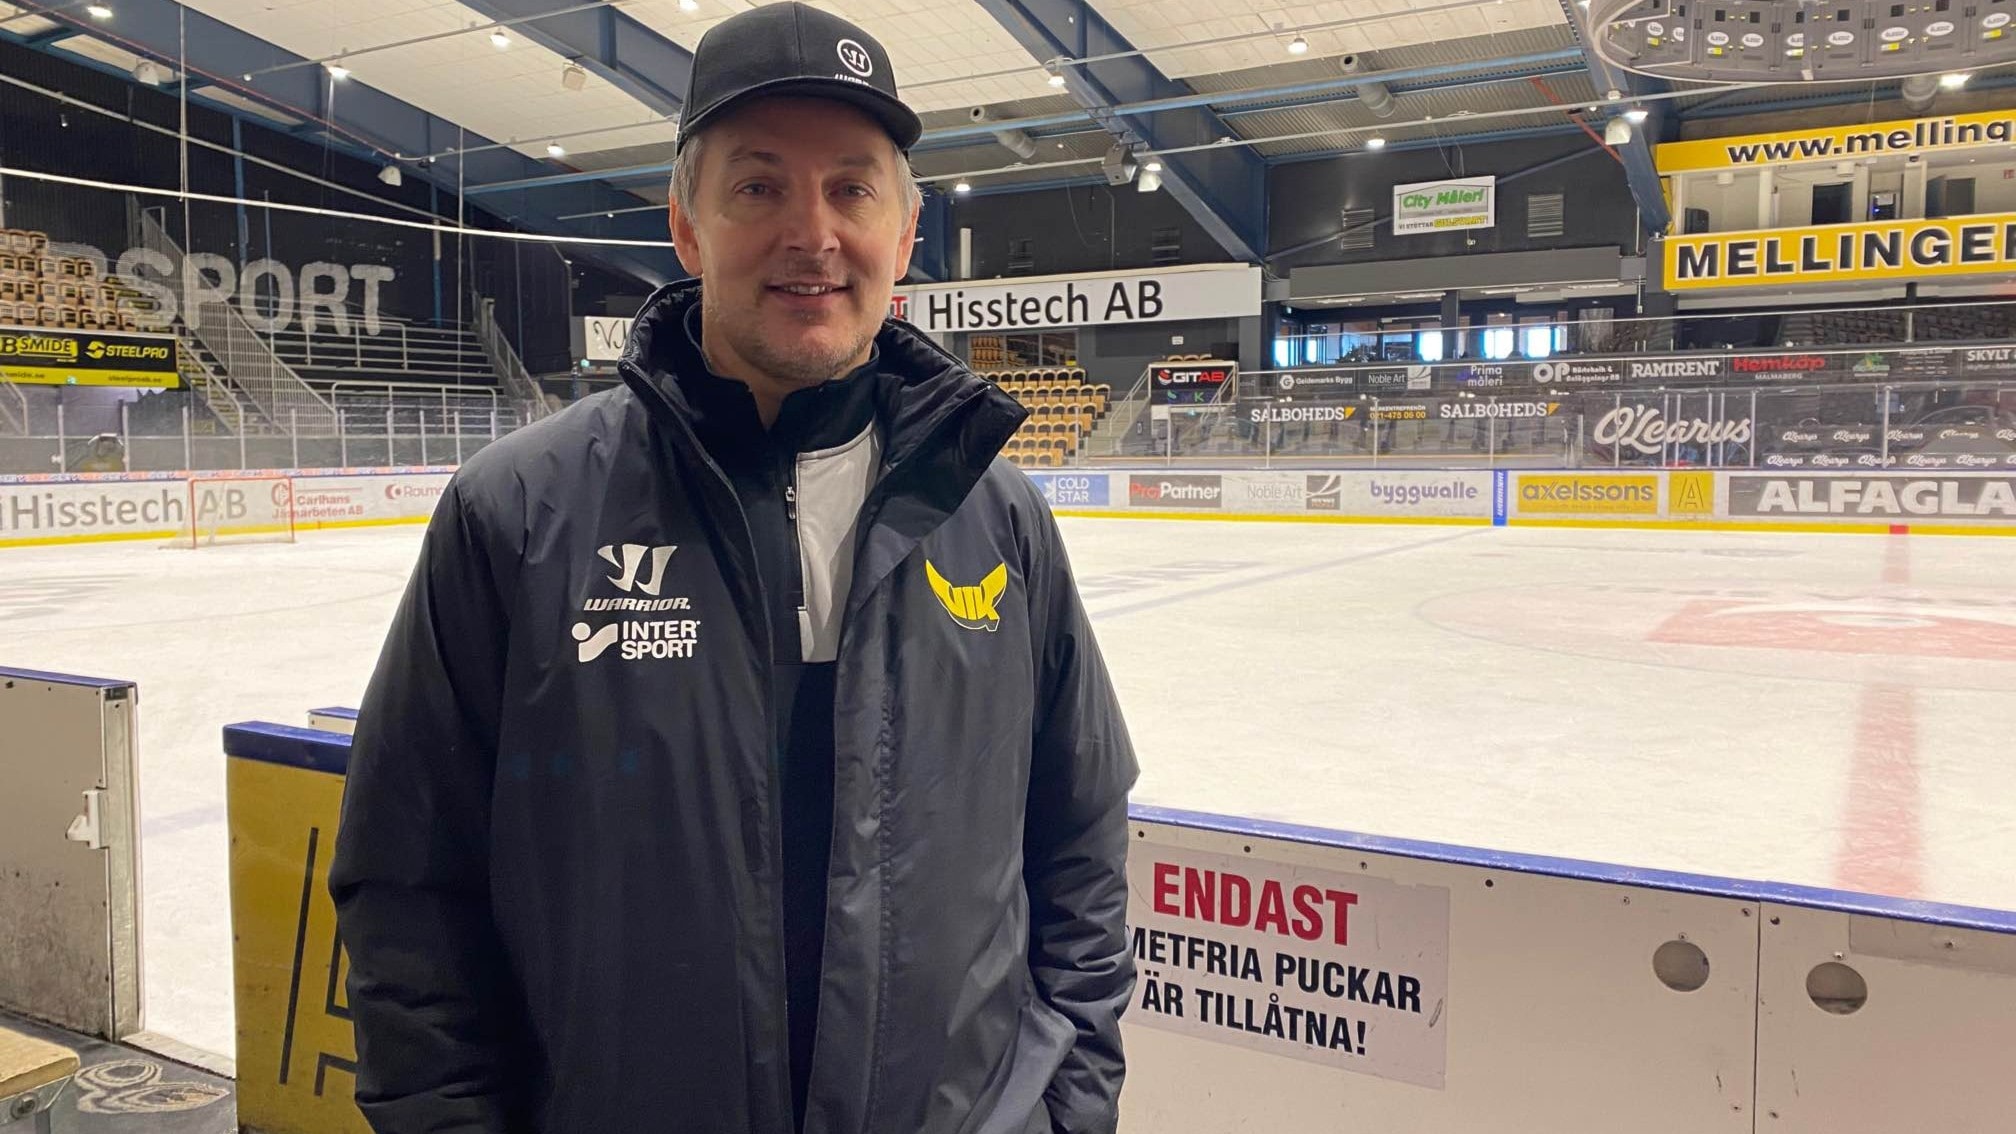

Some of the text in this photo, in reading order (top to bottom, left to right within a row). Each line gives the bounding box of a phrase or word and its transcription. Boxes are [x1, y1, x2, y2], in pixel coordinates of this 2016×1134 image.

[1728, 118, 2013, 164] www.melling
[1403, 188, 1485, 209] City Måleri
[48, 240, 395, 337] SPORT
[929, 280, 1163, 330] Hisstech AB
[106, 345, 168, 358] STEELPRO
[1967, 349, 2011, 361] SKYLT
[1471, 365, 1502, 376] Prima
[1631, 361, 1720, 378] RAMIRENT
[1734, 354, 1825, 372] Hemköp
[1173, 371, 1225, 383] GITAB
[1369, 374, 1405, 384] Noble Art
[1468, 376, 1502, 387] måleri
[1251, 407, 1345, 422] SALBOHEDS
[1440, 402, 1549, 418] SALBOHEDS
[1058, 478, 1089, 489] COLD
[1247, 484, 1302, 499] Noble Art
[1371, 481, 1478, 504] byggwalle
[1522, 481, 1653, 501] axelssons
[1058, 490, 1089, 502] STAR
[1757, 480, 2016, 515] ALFAGLA
[11, 487, 247, 530] Hisstech AB
[583, 598, 689, 611] WARRIOR
[623, 620, 698, 640] INTER
[621, 639, 698, 660] SPORT
[1153, 862, 1359, 946] ENDAST
[1275, 952, 1422, 1013] PUCKAR
[1141, 970, 1367, 1056] ÄR TILLÅTNA!
